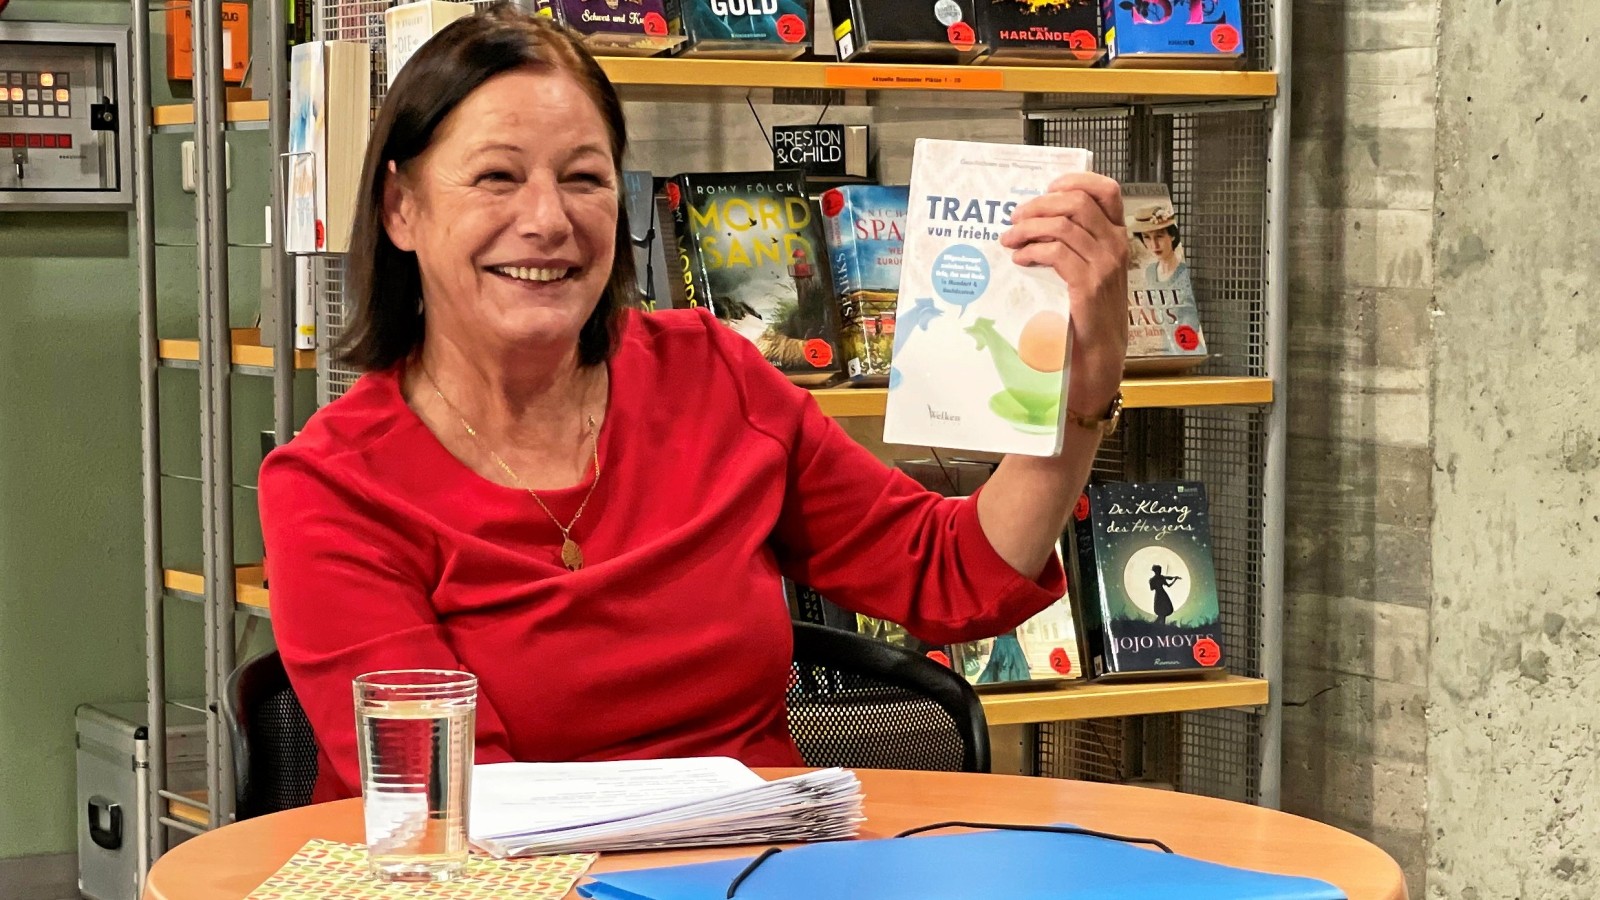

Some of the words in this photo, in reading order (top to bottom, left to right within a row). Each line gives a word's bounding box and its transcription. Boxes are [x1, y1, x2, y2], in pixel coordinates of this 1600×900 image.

[613, 13, 626, 23] und
[782, 25, 790, 34] 2
[953, 31, 961, 41] 2
[1217, 34, 1225, 43] 2
[1074, 39, 1082, 50] 2
[774, 130, 841, 147] PRESTON
[696, 185, 737, 194] ROMY
[746, 183, 794, 193] FÖLCK
[687, 197, 811, 233] MORD
[928, 226, 952, 238] vun
[702, 232, 813, 268] SAND
[836, 252, 853, 318] SPARKS
[1180, 334, 1187, 343] 2
[810, 349, 818, 359] 2
[1108, 503, 1133, 515] Der
[1135, 500, 1192, 523] Klang
[1106, 521, 1128, 533] des
[1131, 519, 1195, 540] Herzens
[1114, 636, 1153, 653] JOJO
[1198, 648, 1206, 657] 2
[1054, 658, 1062, 667] 2
